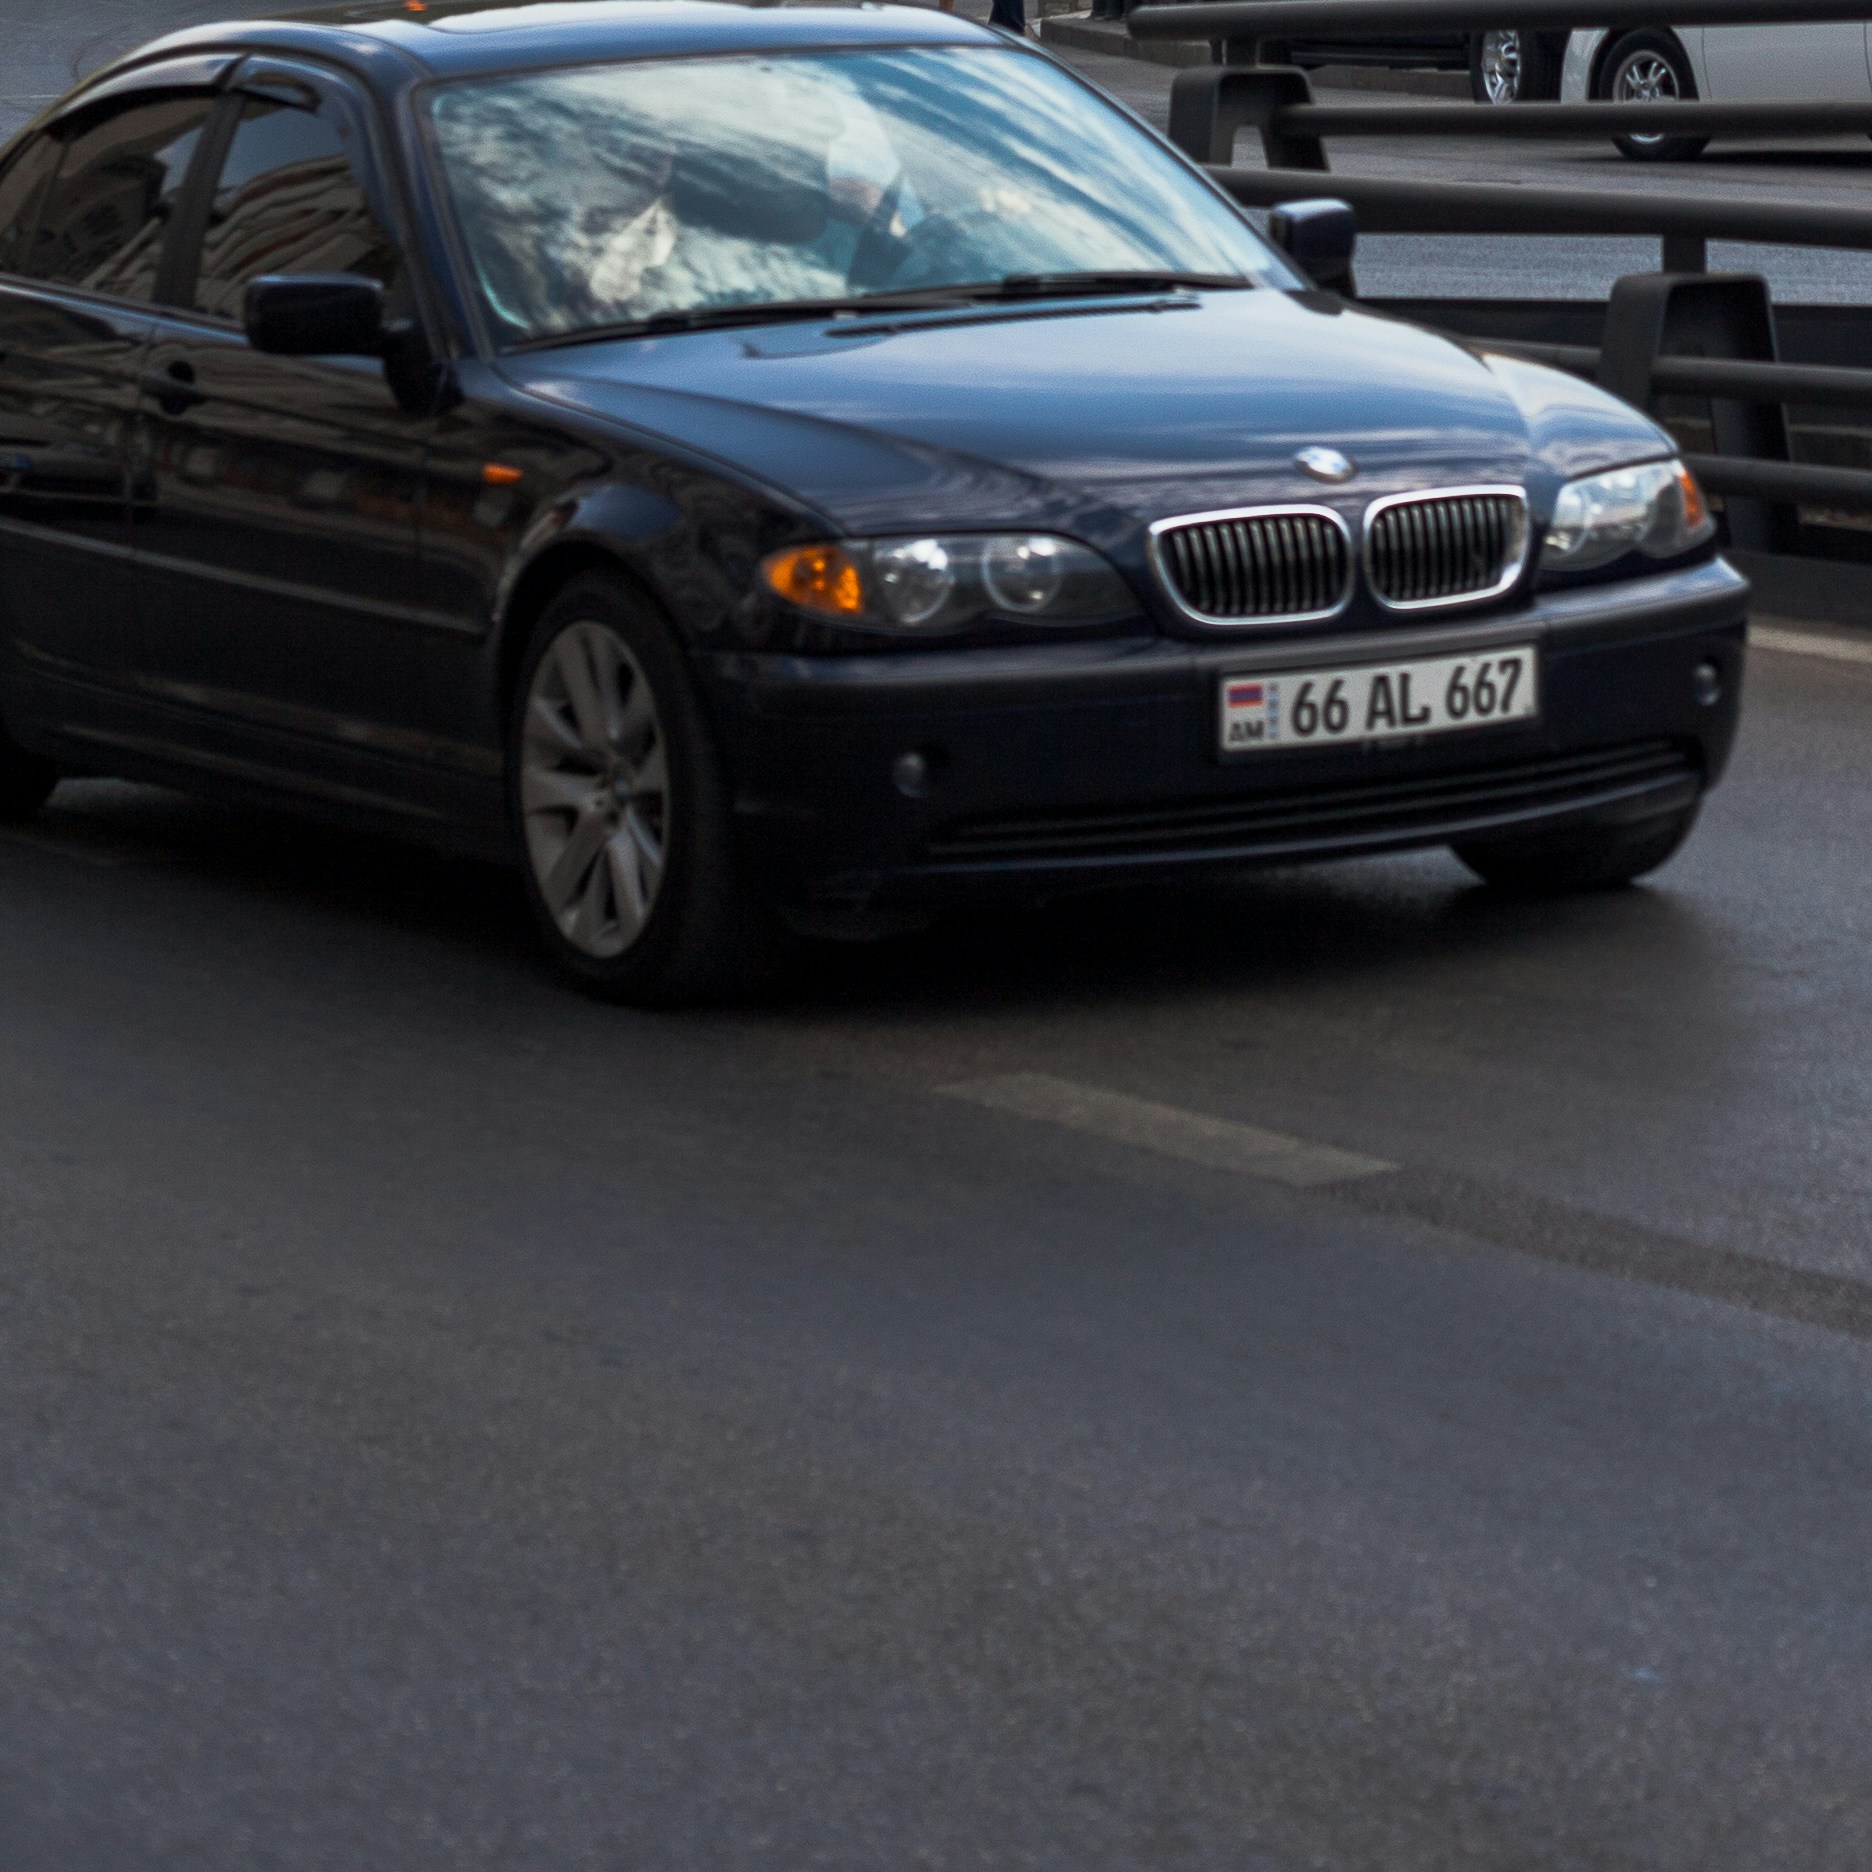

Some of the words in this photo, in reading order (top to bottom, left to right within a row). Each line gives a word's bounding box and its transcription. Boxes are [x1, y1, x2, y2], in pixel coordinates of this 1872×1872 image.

[1290, 679, 1350, 737] 66
[1365, 672, 1432, 731] AL
[1444, 657, 1523, 720] 667
[1228, 720, 1265, 742] AM
